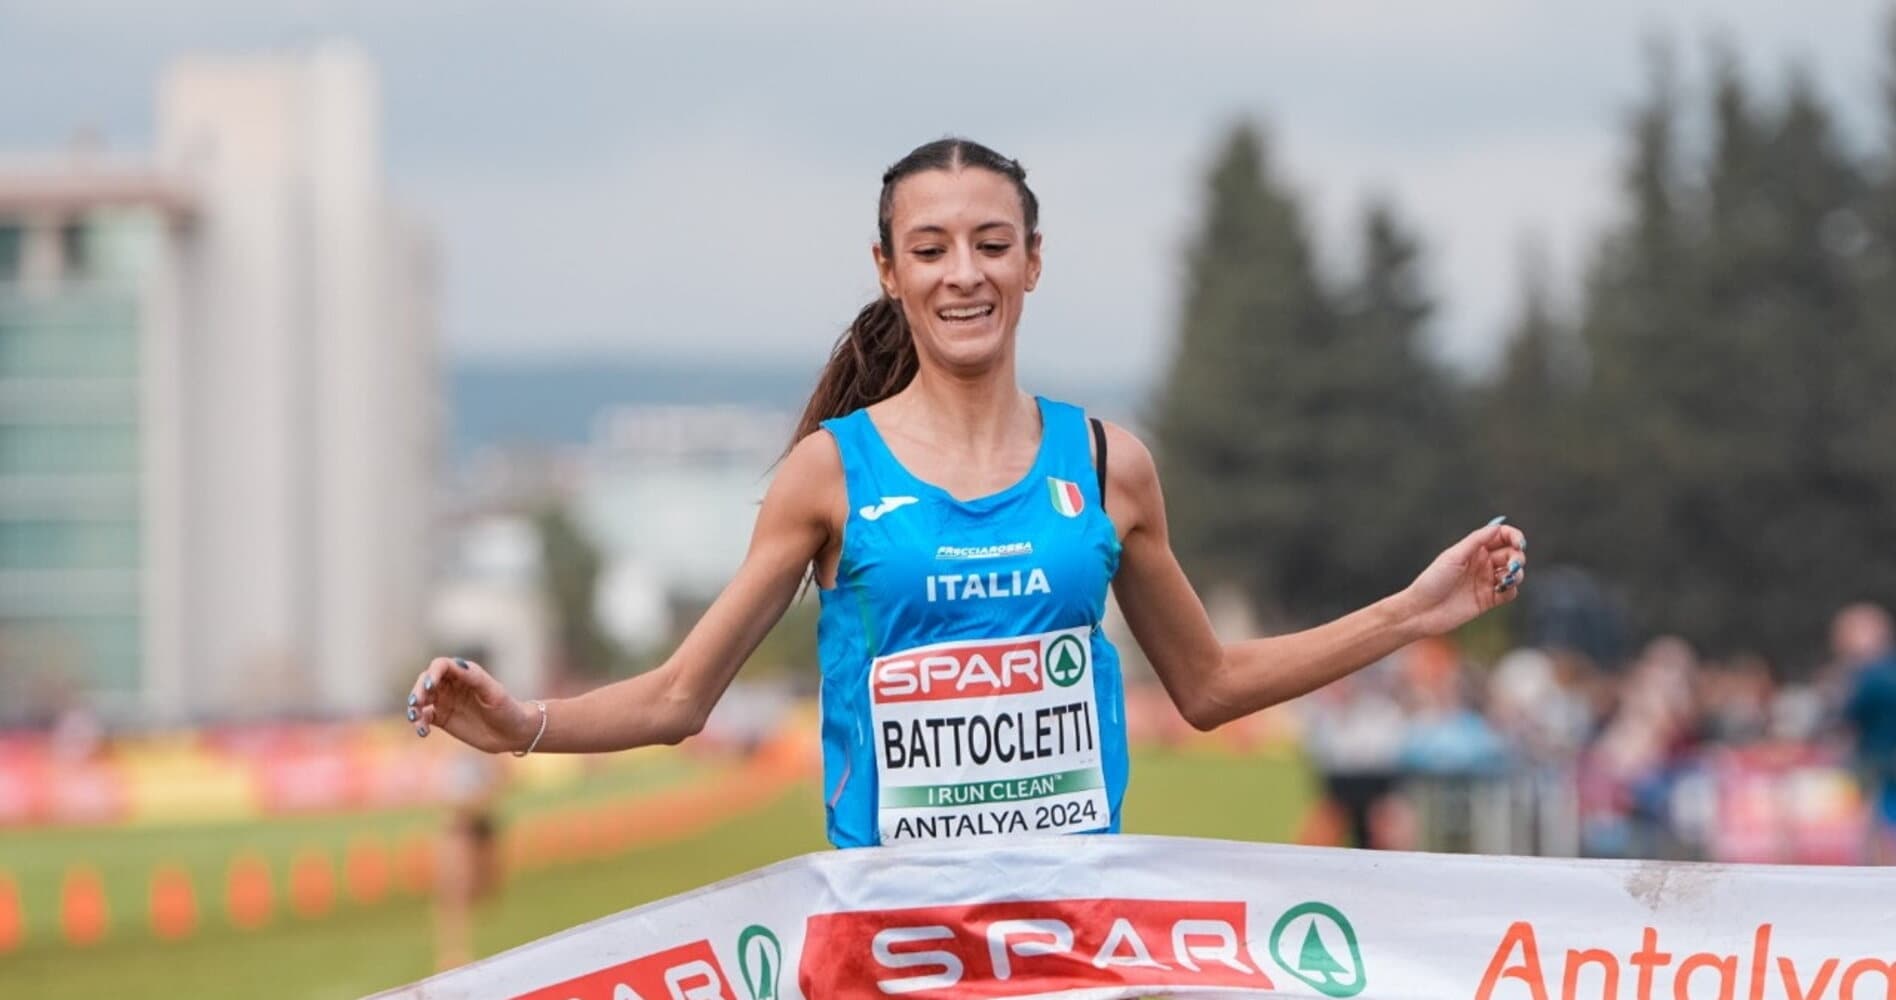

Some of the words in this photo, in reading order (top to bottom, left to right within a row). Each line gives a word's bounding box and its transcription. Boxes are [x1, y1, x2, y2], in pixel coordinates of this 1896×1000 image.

[926, 568, 1051, 602] ITALIA
[878, 648, 1040, 697] SPAR
[882, 701, 1094, 769] BATTOCLETTI
[928, 788, 934, 805] I
[938, 785, 985, 804] RUN
[894, 810, 1028, 839] ANTALYA
[1035, 799, 1098, 830] 2024
[871, 917, 1255, 995] SPAR
